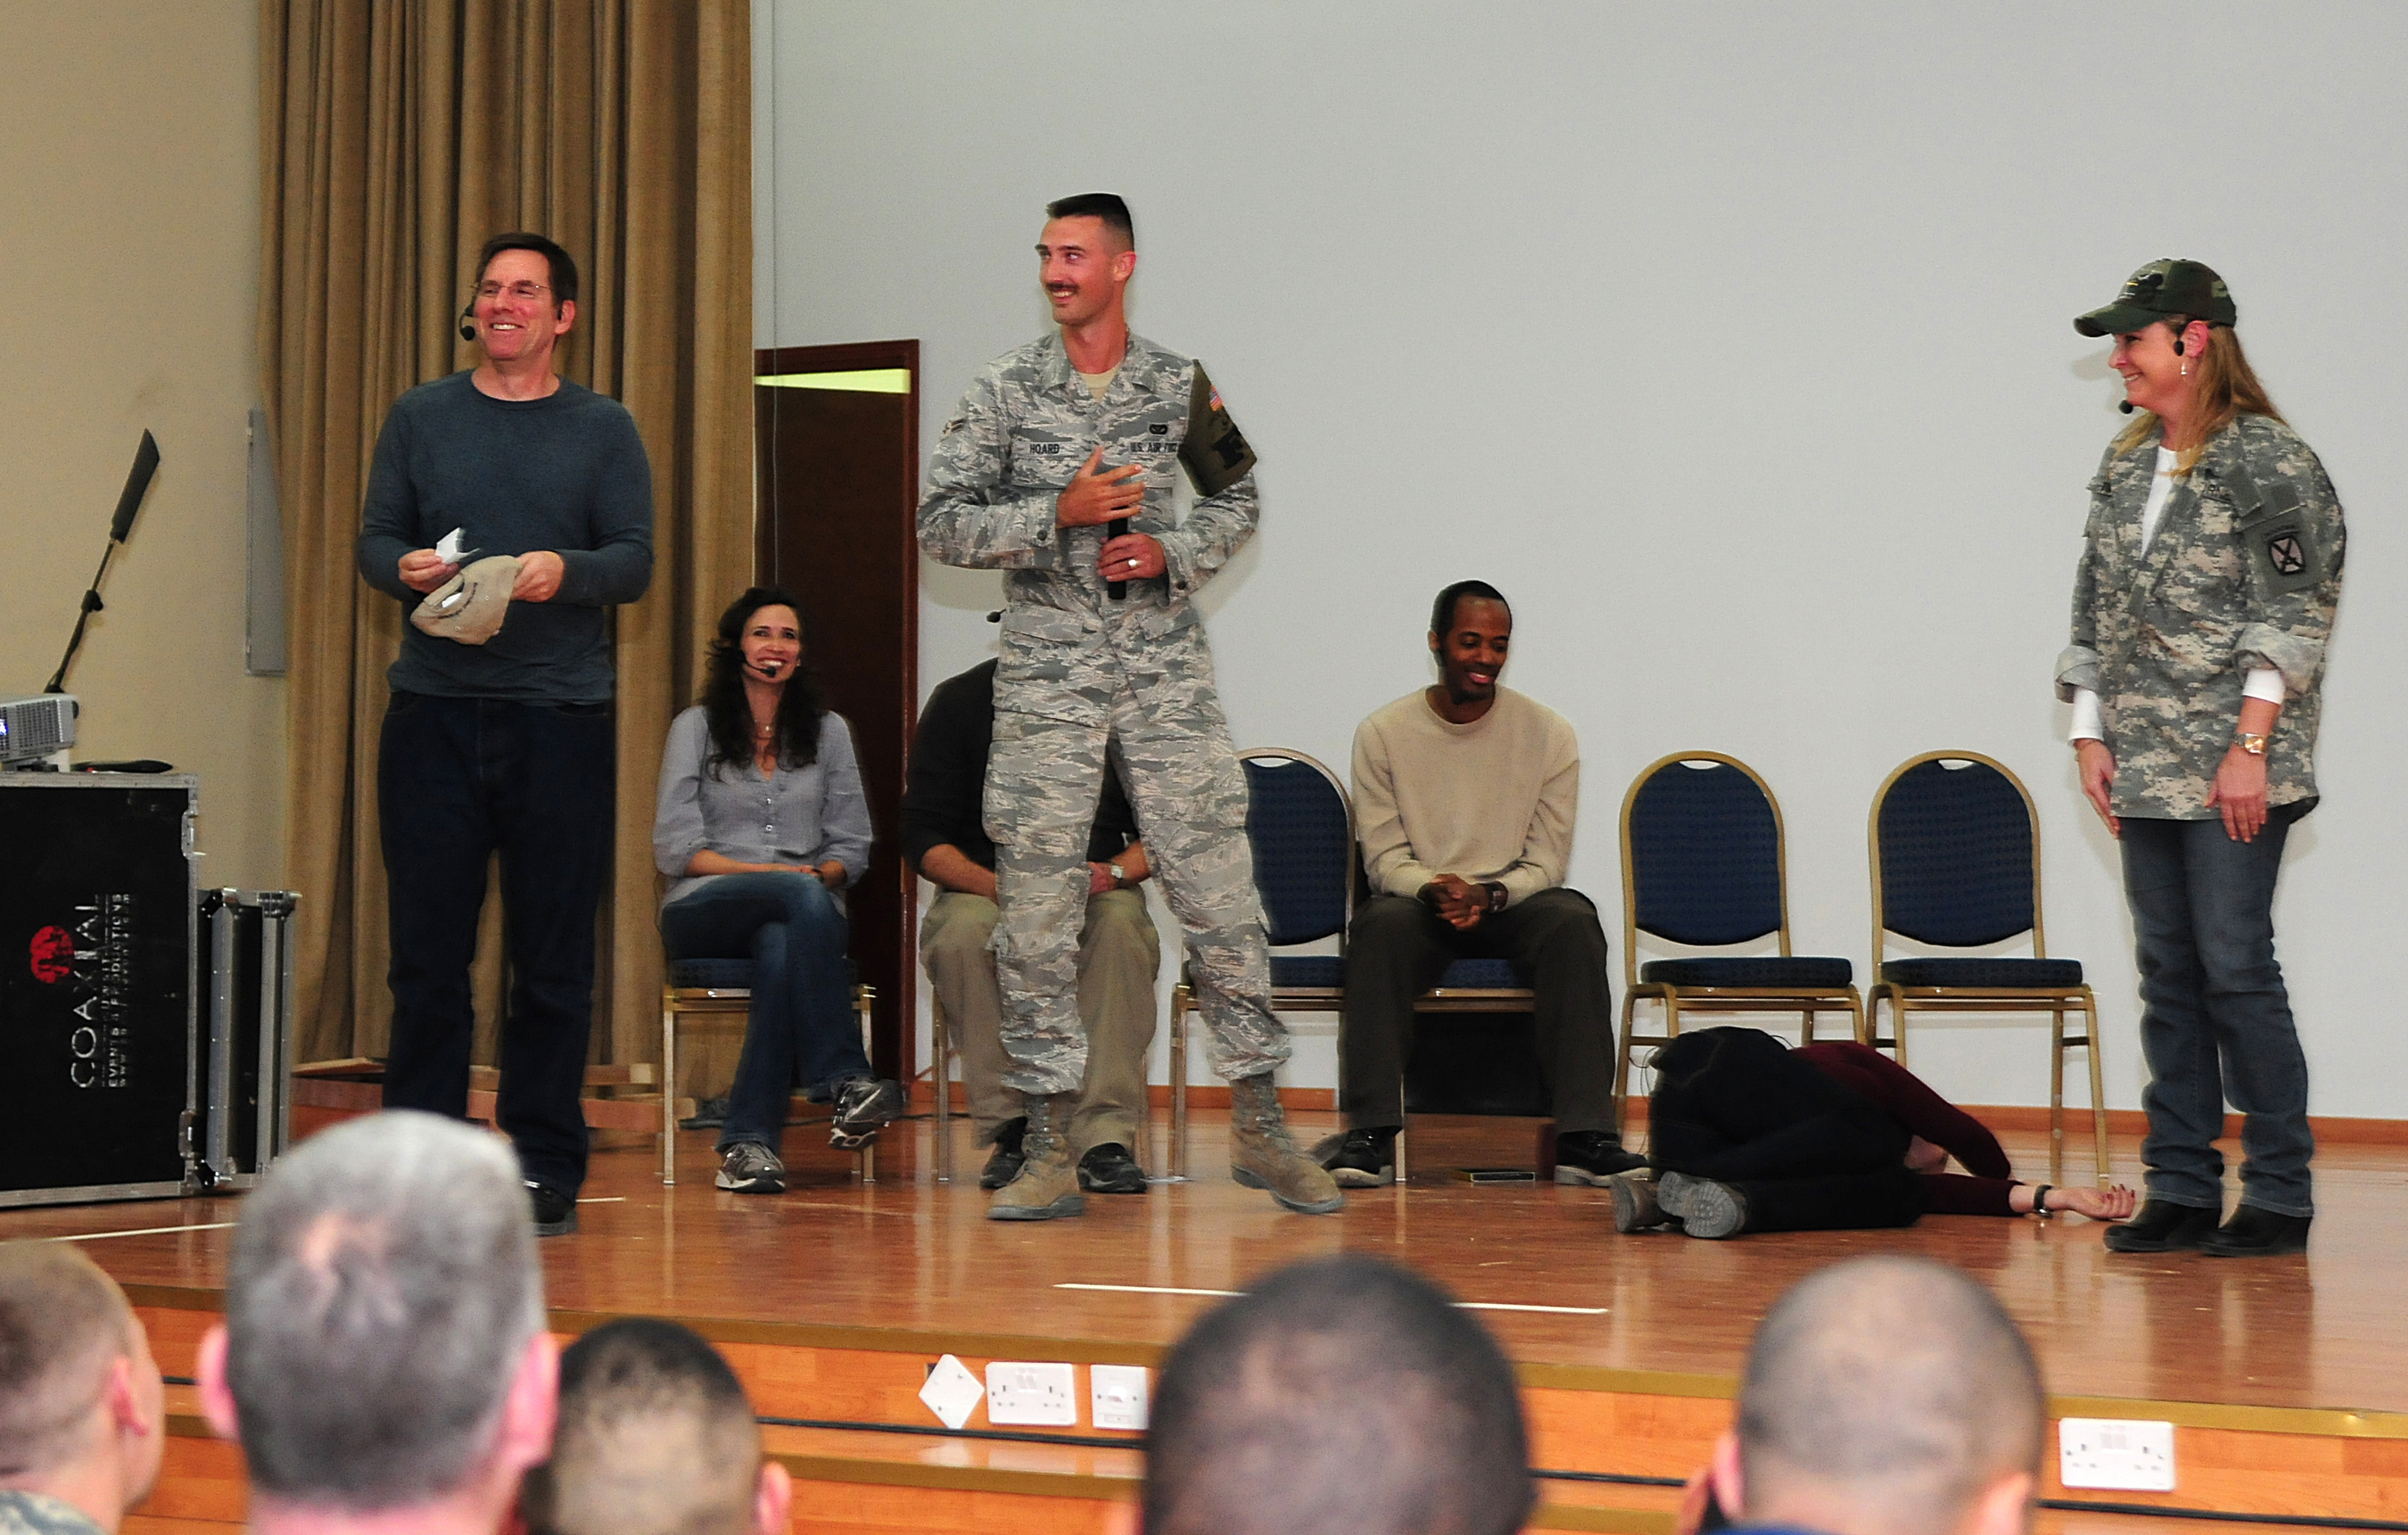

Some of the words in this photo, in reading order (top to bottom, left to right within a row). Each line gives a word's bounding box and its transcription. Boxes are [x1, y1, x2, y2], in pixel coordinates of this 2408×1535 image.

[1029, 443, 1060, 454] HOARD
[1147, 442, 1161, 452] AIR
[70, 894, 99, 1088] COAXIAL
[100, 957, 111, 1021] UWAIT
